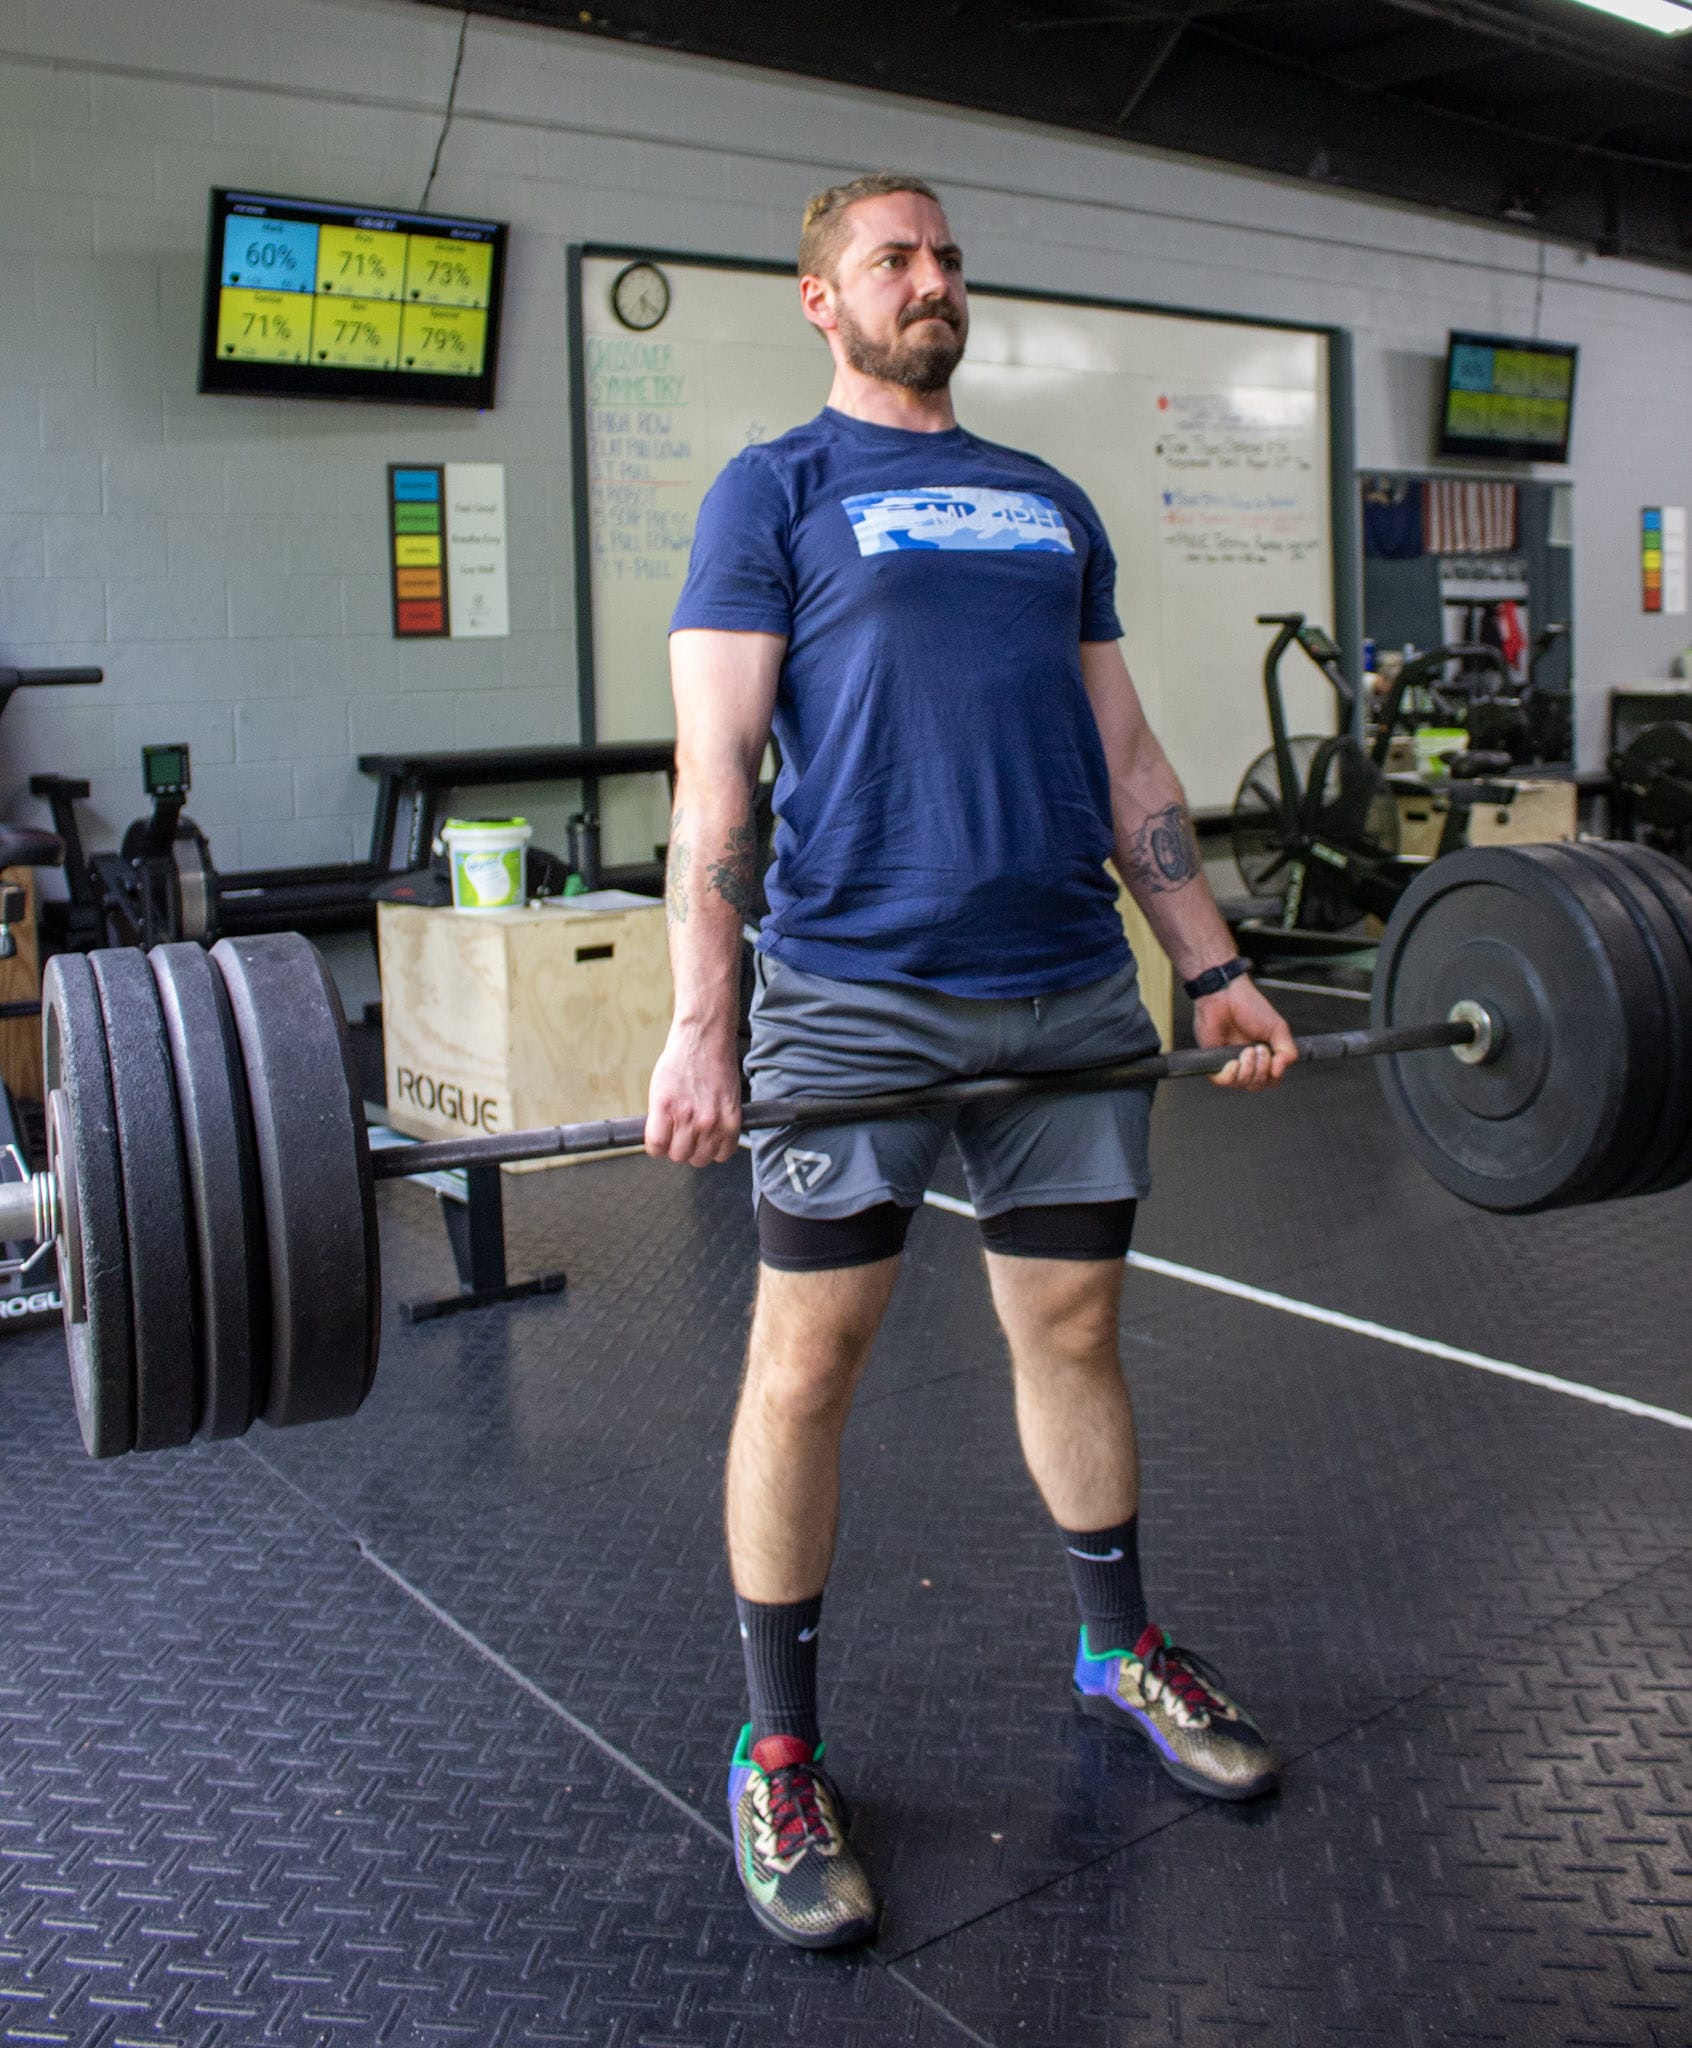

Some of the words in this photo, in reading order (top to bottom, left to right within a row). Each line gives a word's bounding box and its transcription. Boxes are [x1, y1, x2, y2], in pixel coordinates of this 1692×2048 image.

[245, 241, 297, 270] 60%
[337, 250, 387, 279] 71%
[425, 259, 472, 287] 73%
[241, 312, 292, 340] 71%
[333, 319, 381, 348] 77%
[421, 326, 466, 353] 79%
[397, 1065, 498, 1134] ROGUE
